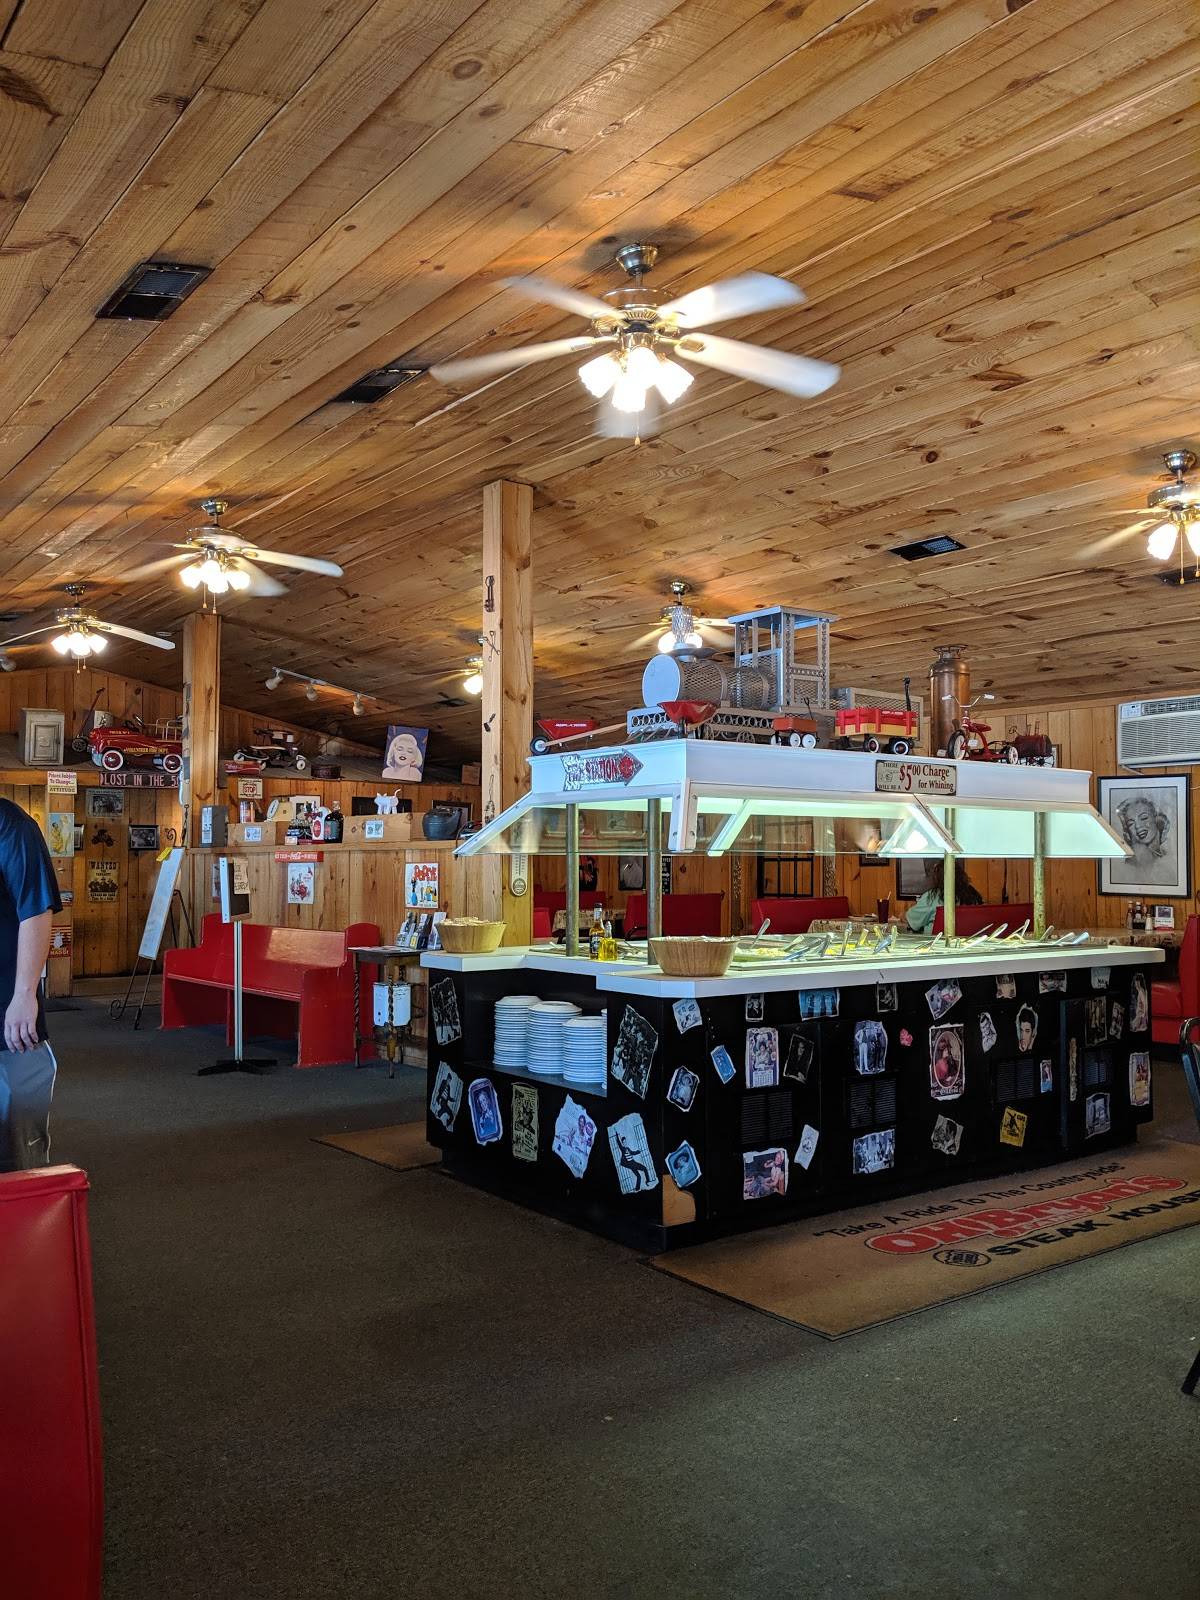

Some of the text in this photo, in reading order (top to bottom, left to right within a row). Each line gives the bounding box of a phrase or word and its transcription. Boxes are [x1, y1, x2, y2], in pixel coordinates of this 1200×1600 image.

[104, 773, 127, 786] LOST
[133, 774, 142, 786] IN
[149, 774, 164, 787] THE
[922, 764, 950, 781] Charge
[243, 785, 257, 793] STOP
[919, 779, 954, 793] for Whining
[883, 1215, 906, 1225] A
[903, 1204, 958, 1219] Ride
[950, 1197, 987, 1207] To
[978, 1188, 1026, 1200] The
[987, 1219, 1112, 1256] STEAK
